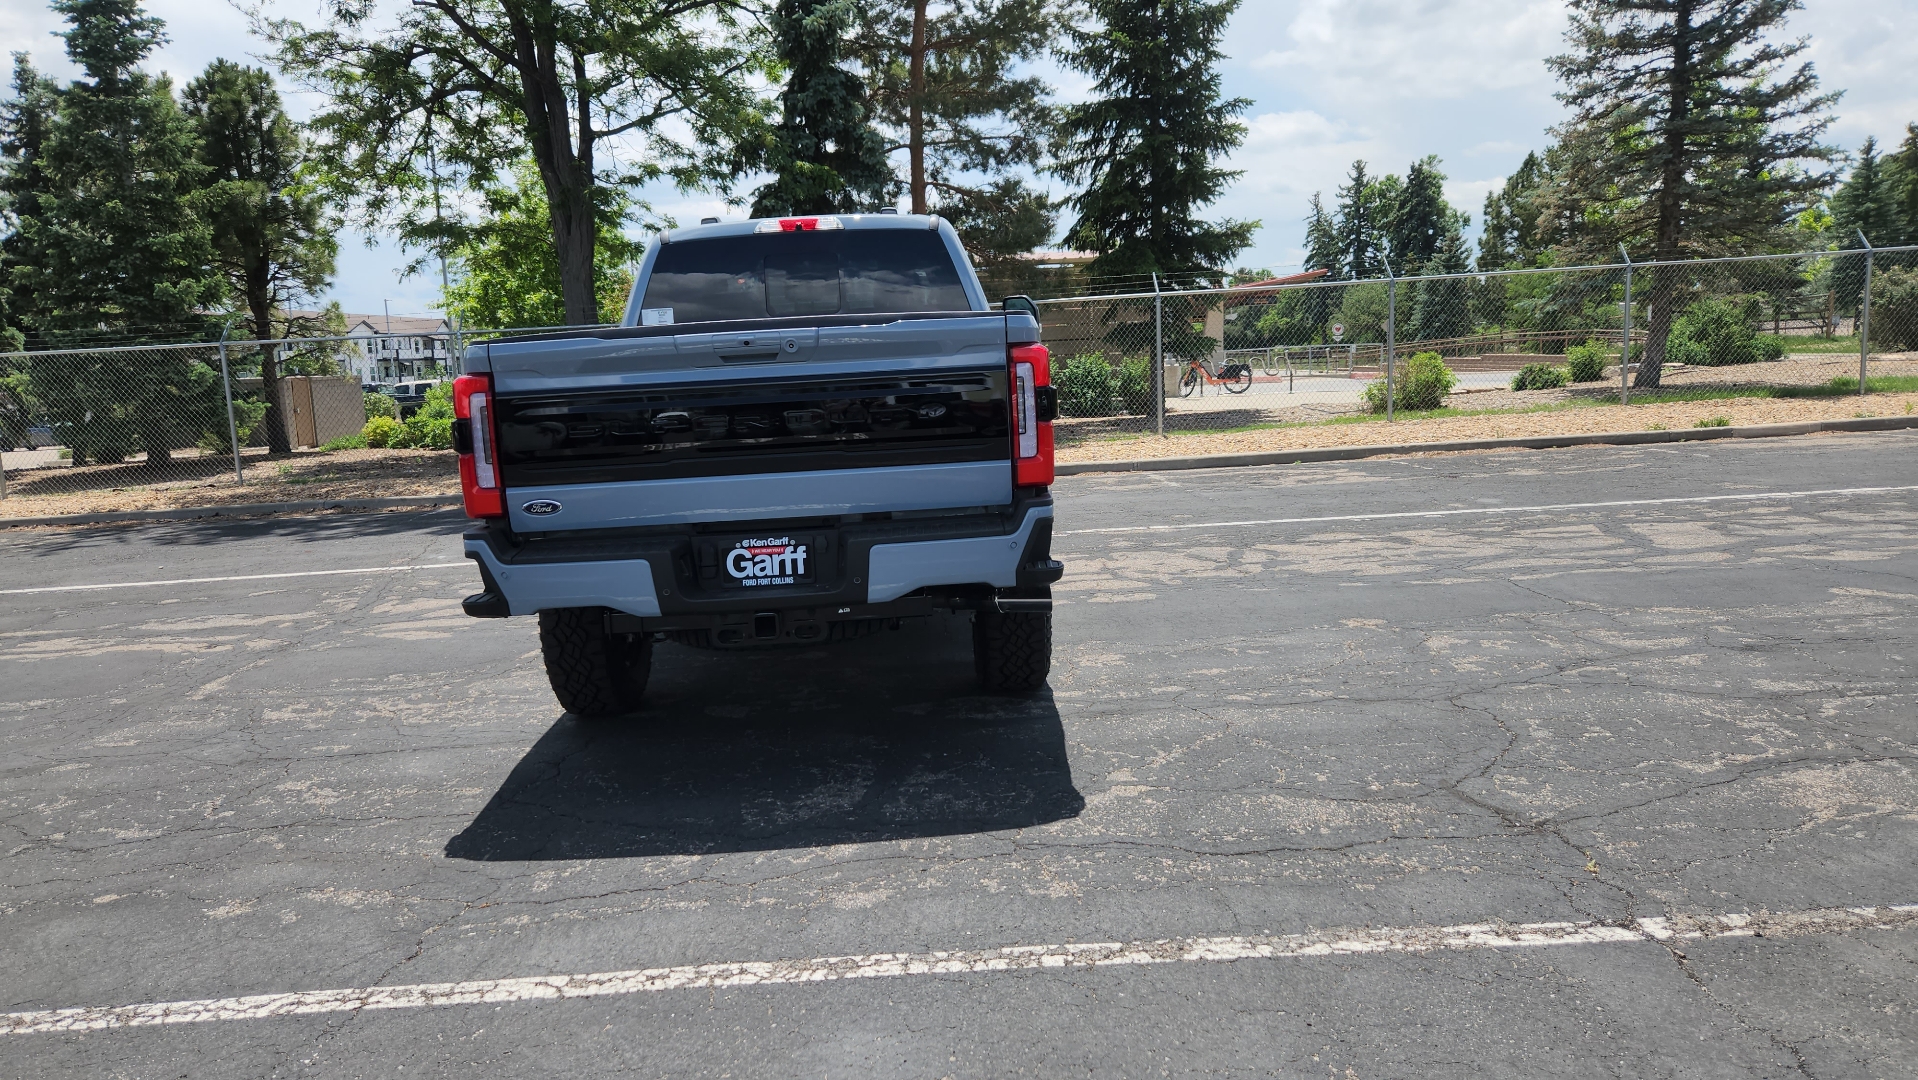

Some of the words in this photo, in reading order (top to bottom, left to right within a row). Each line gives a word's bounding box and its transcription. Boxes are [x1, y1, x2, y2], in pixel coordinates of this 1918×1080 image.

[530, 503, 553, 513] Ford
[750, 539, 767, 547] Ken
[767, 537, 789, 546] Garff
[726, 546, 807, 578] Garff
[757, 577, 771, 586] FORT
[772, 577, 794, 585] COLLINS
